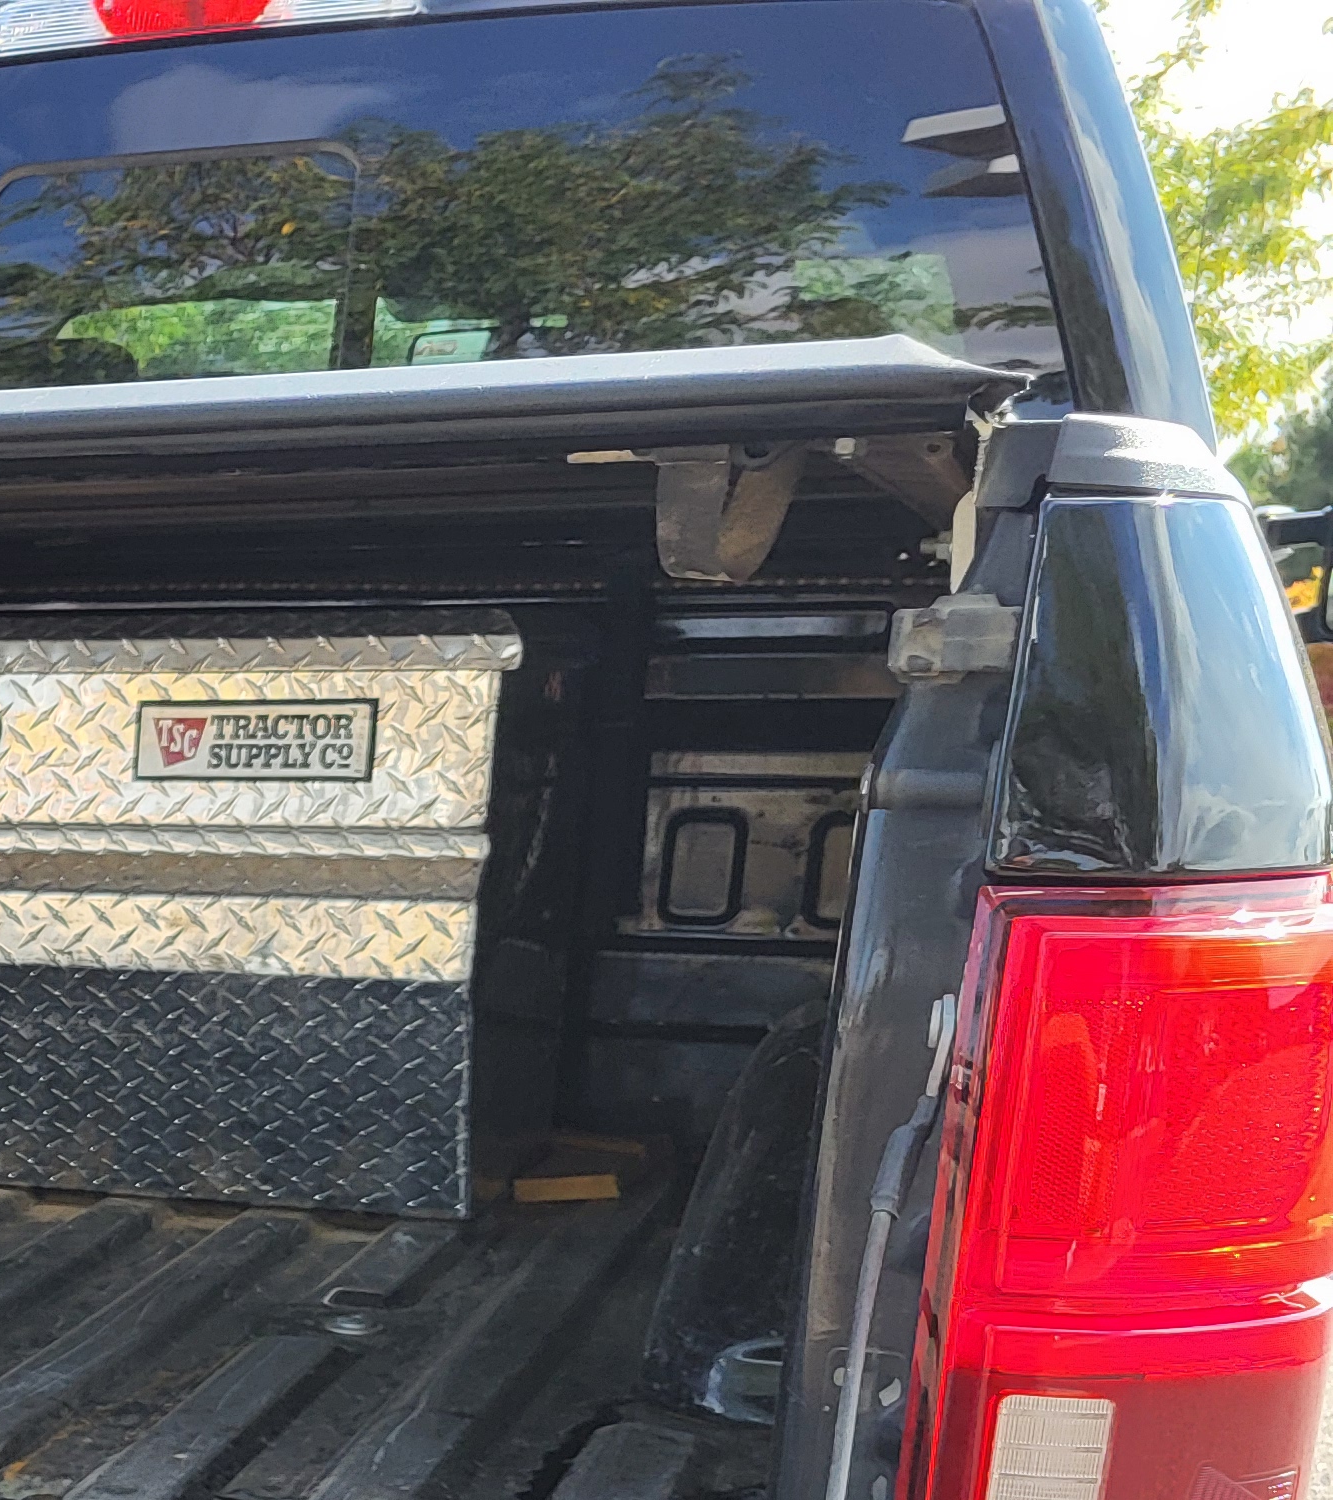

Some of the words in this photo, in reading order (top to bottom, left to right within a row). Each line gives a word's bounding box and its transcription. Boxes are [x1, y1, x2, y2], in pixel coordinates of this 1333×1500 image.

[158, 719, 199, 758] TSC
[210, 714, 354, 740] TRACTOR
[206, 742, 317, 770] SUPPLY
